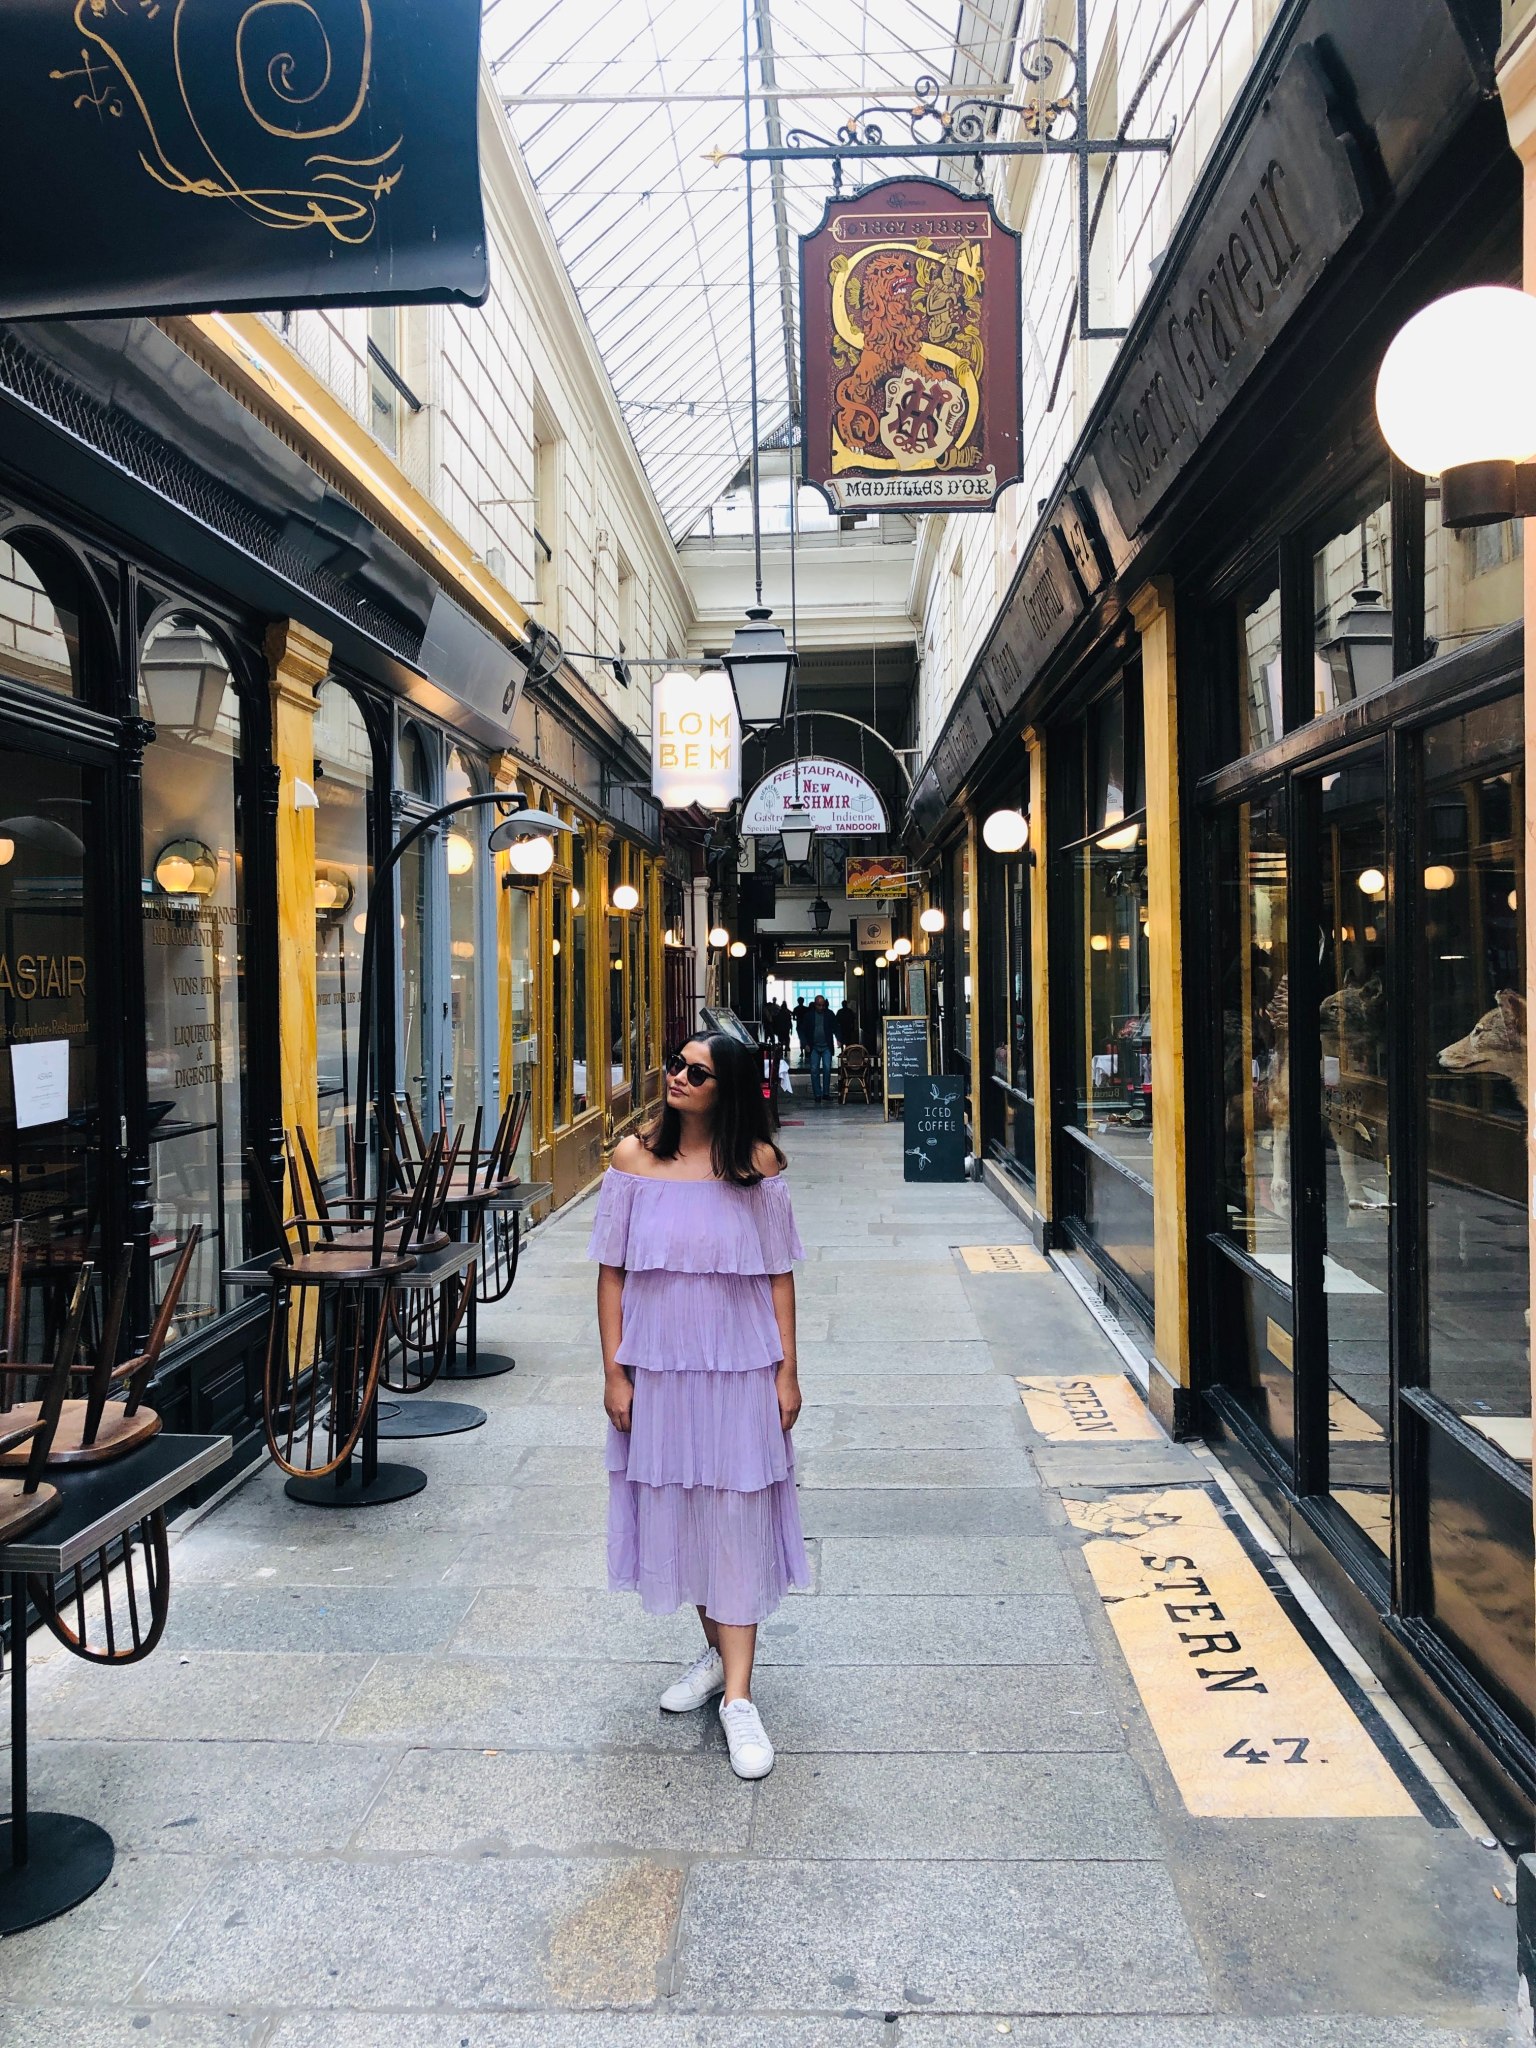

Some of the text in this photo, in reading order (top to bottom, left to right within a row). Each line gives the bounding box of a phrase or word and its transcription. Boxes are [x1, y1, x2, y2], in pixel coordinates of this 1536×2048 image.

[1110, 159, 1302, 500] Stern Graveur
[947, 478, 992, 496] D'OR
[1069, 521, 1090, 567] 47
[659, 712, 732, 738] LOM
[659, 743, 732, 769] BEM
[773, 765, 862, 788] RESTAURANT
[831, 811, 875, 822] Indienne
[835, 823, 880, 831] TANDOORI
[173, 976, 222, 996] VINS FINS
[174, 1023, 222, 1048] LIQUEURS
[924, 1106, 951, 1118] ICED
[917, 1120, 956, 1132] COFFEE
[986, 1247, 1023, 1271] STERN
[1056, 1381, 1118, 1433] STERN
[1140, 1555, 1269, 1694] STERN
